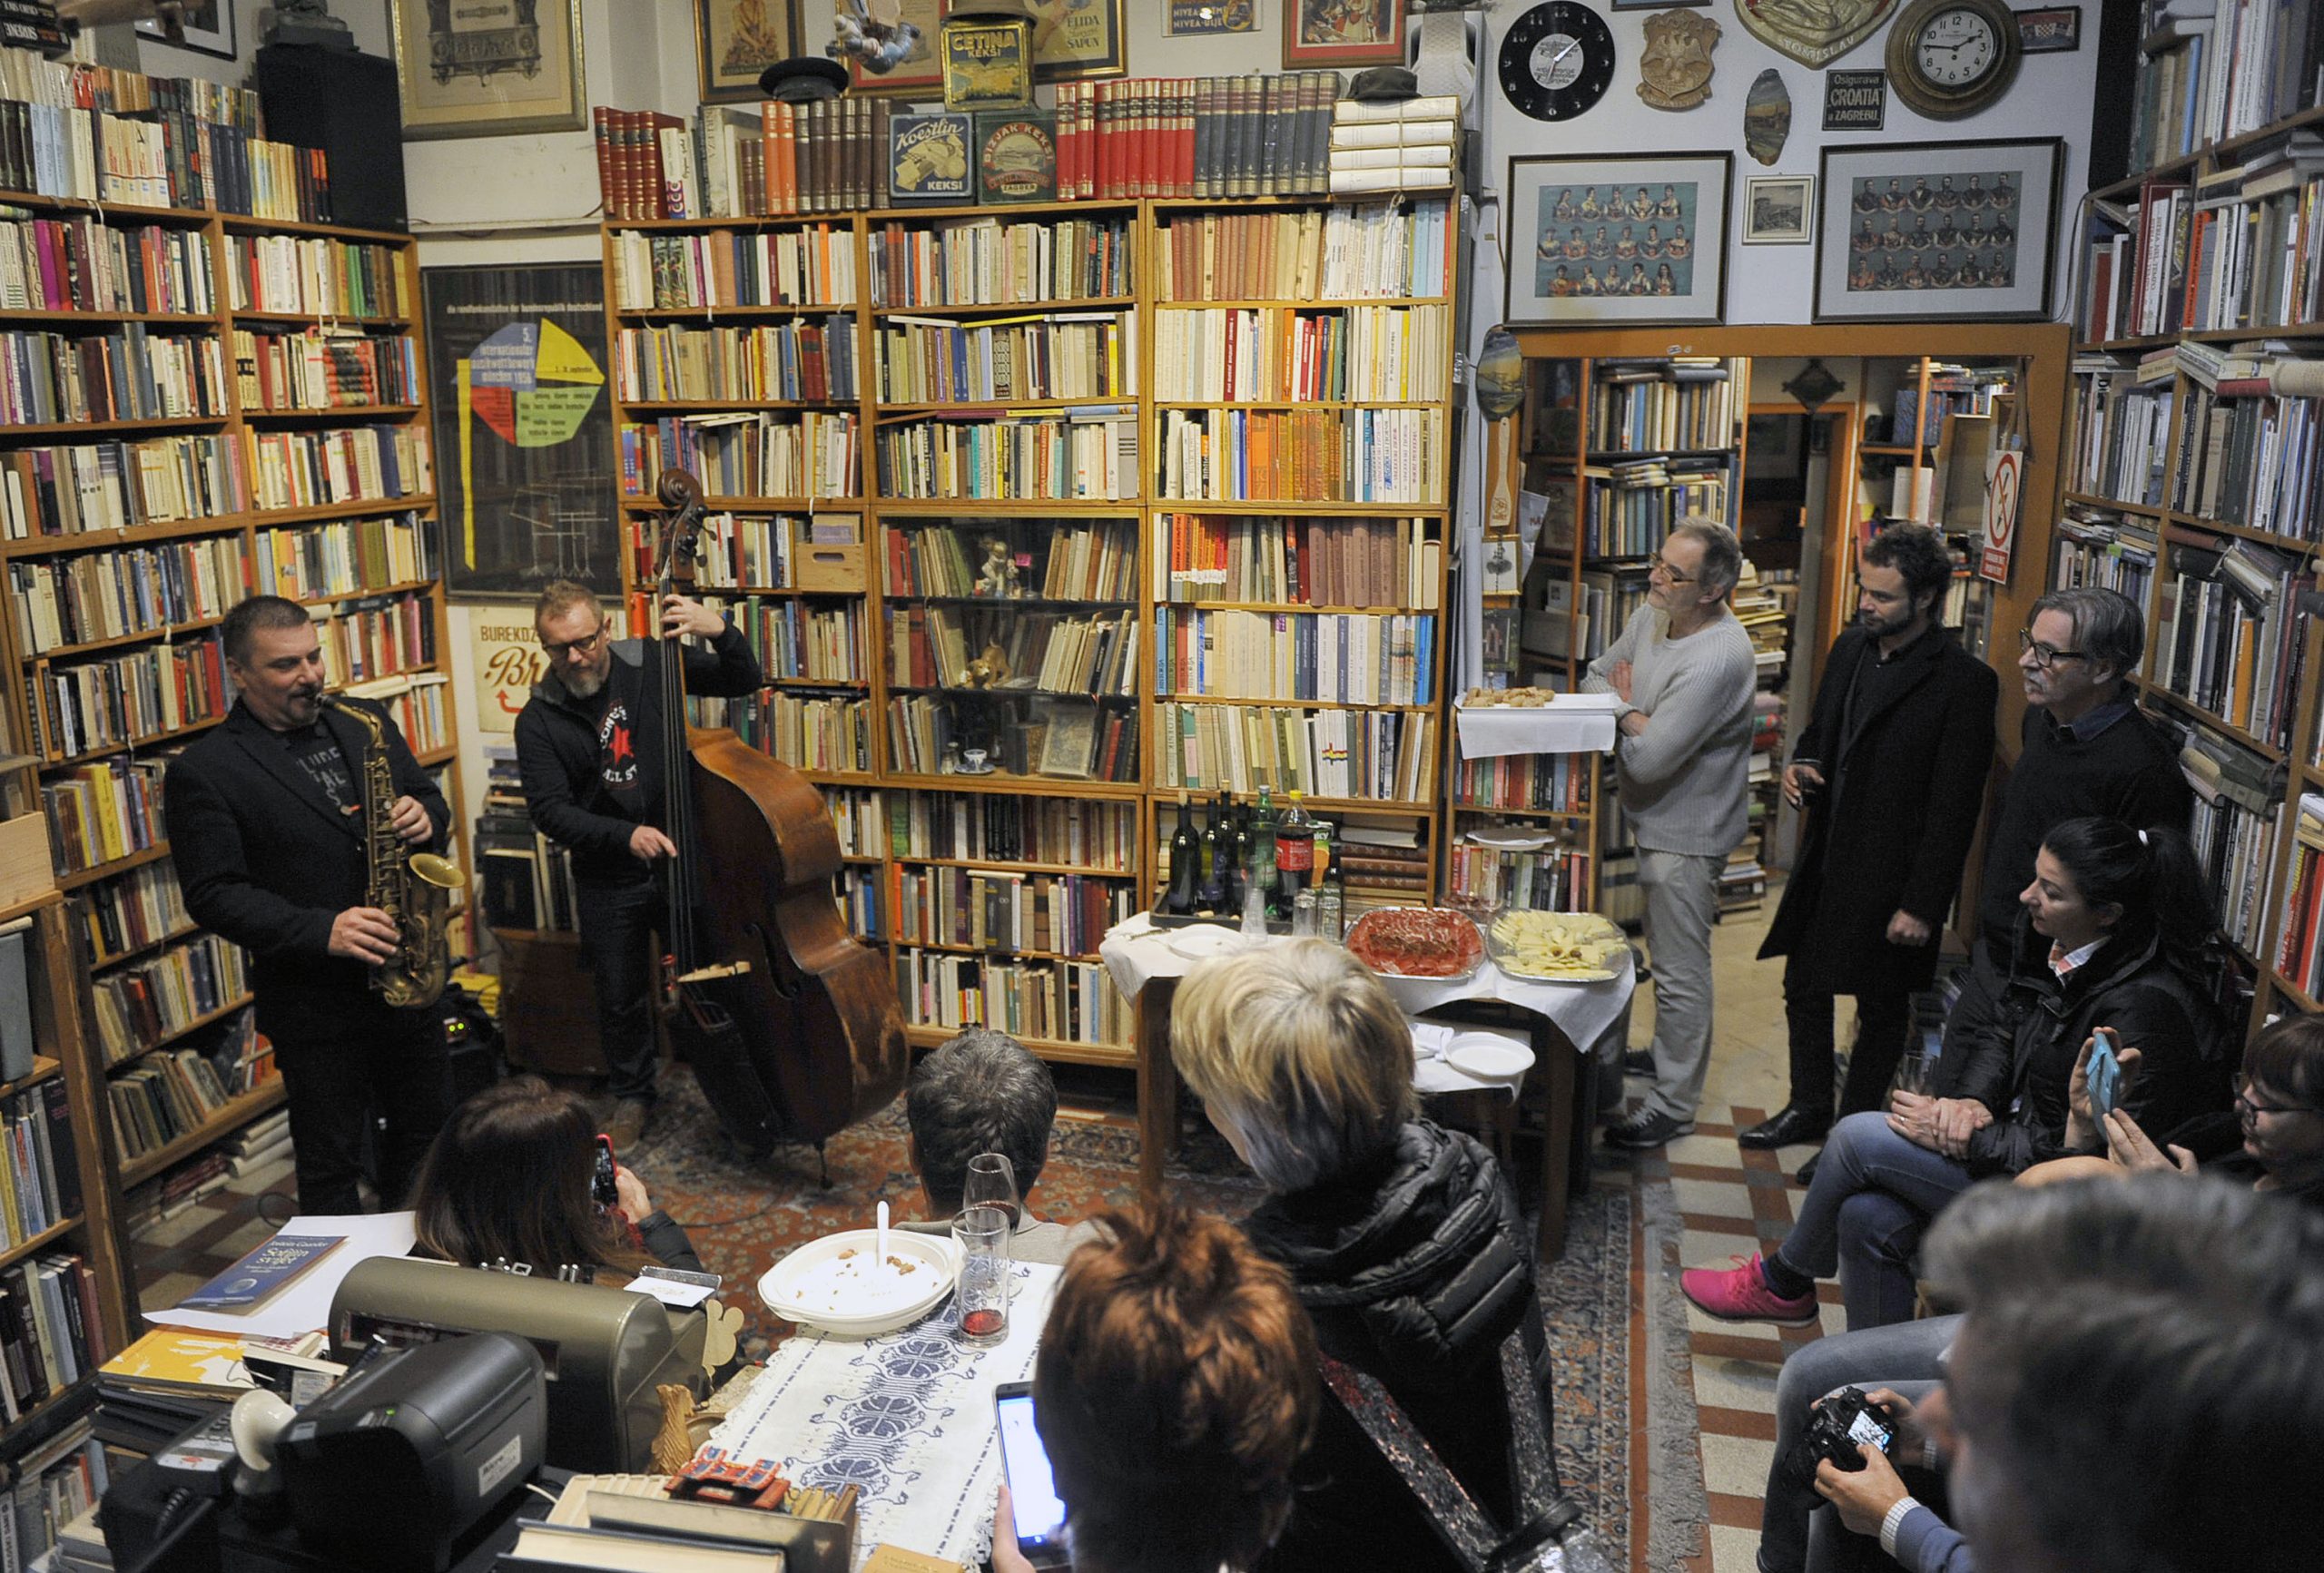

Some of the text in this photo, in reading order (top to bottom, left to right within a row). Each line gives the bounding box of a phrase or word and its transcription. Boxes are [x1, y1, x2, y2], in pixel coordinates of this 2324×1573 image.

[1067, 15, 1100, 27] ELIDA
[1939, 20, 1947, 30] 11
[1951, 15, 1962, 26] 12
[1926, 30, 1936, 40] 10
[1977, 30, 1984, 39] 2
[952, 31, 1017, 51] CETINA
[1067, 36, 1099, 49] SAPUN
[968, 47, 1000, 58] KEKSI
[1783, 36, 1855, 61] TOMISLAV
[1980, 43, 1986, 52] 3
[1926, 58, 1933, 67] 8
[1974, 57, 1980, 65] 4
[1936, 68, 1942, 77] 7
[1949, 71, 1955, 80] 6
[1963, 67, 1970, 76] 5
[1834, 74, 1879, 85] Osigurava
[895, 118, 964, 152] Koestlin
[984, 124, 1053, 162] BIZJAK KEKSI
[927, 181, 963, 191] KEKSI
[522, 328, 532, 342] 5.
[480, 625, 539, 643] BUREKDŽ
[488, 646, 542, 687] Br
